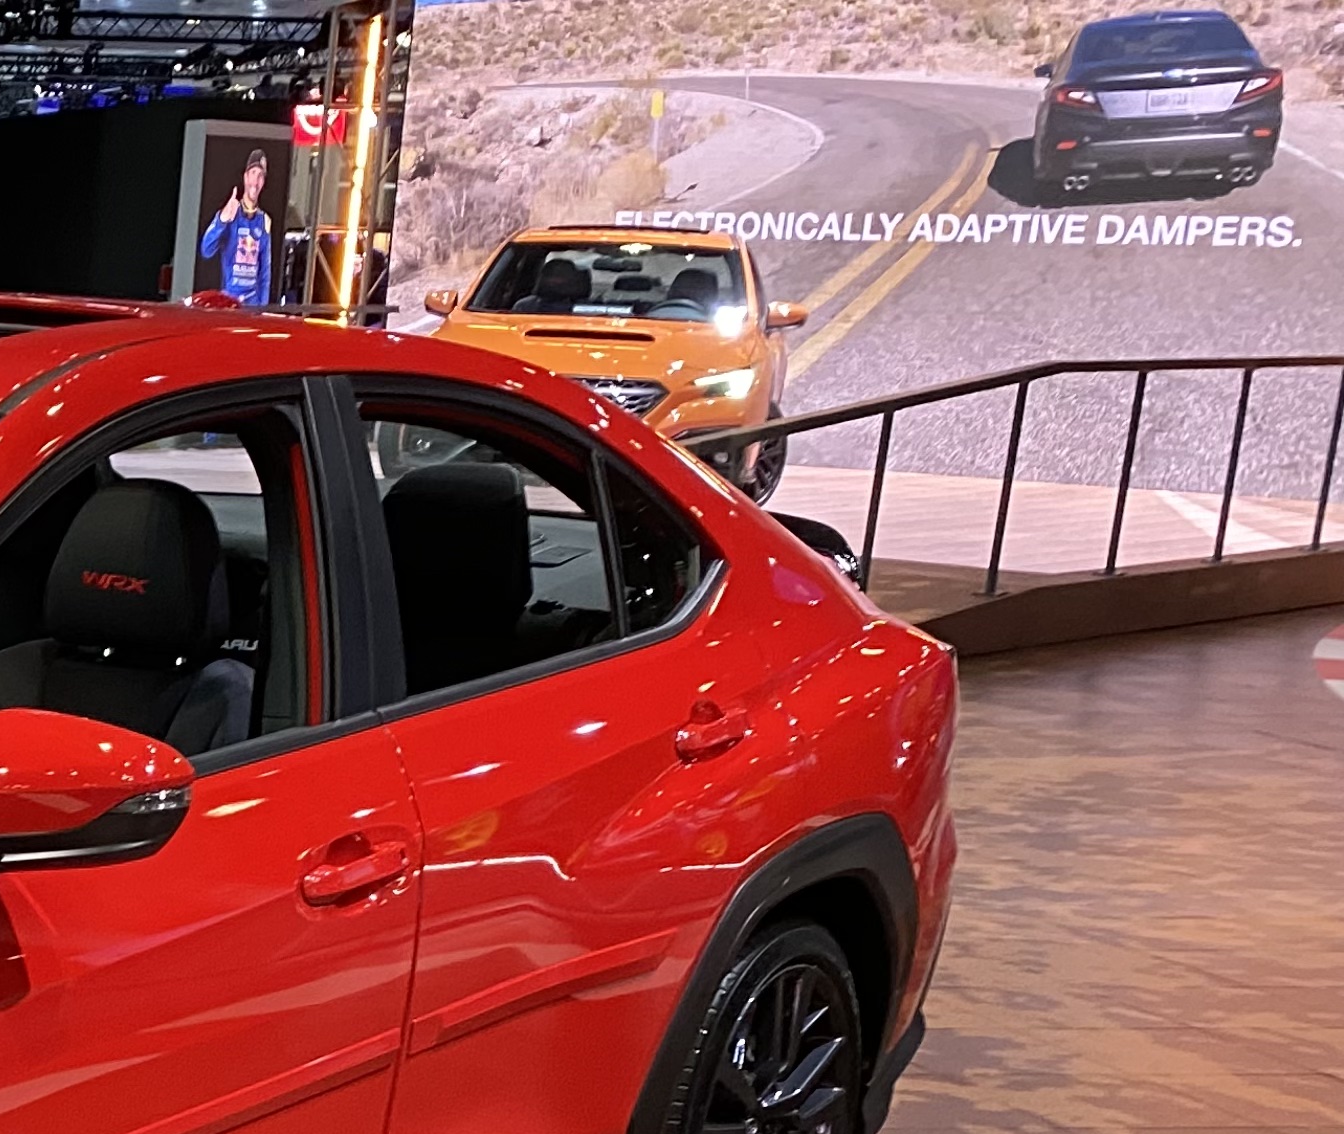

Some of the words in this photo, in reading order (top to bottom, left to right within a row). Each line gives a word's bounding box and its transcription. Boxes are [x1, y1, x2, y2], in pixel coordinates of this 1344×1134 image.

[908, 213, 1089, 244] ADAPTIVE
[1096, 215, 1303, 248] DAMPERS.
[81, 570, 150, 595] WRX
